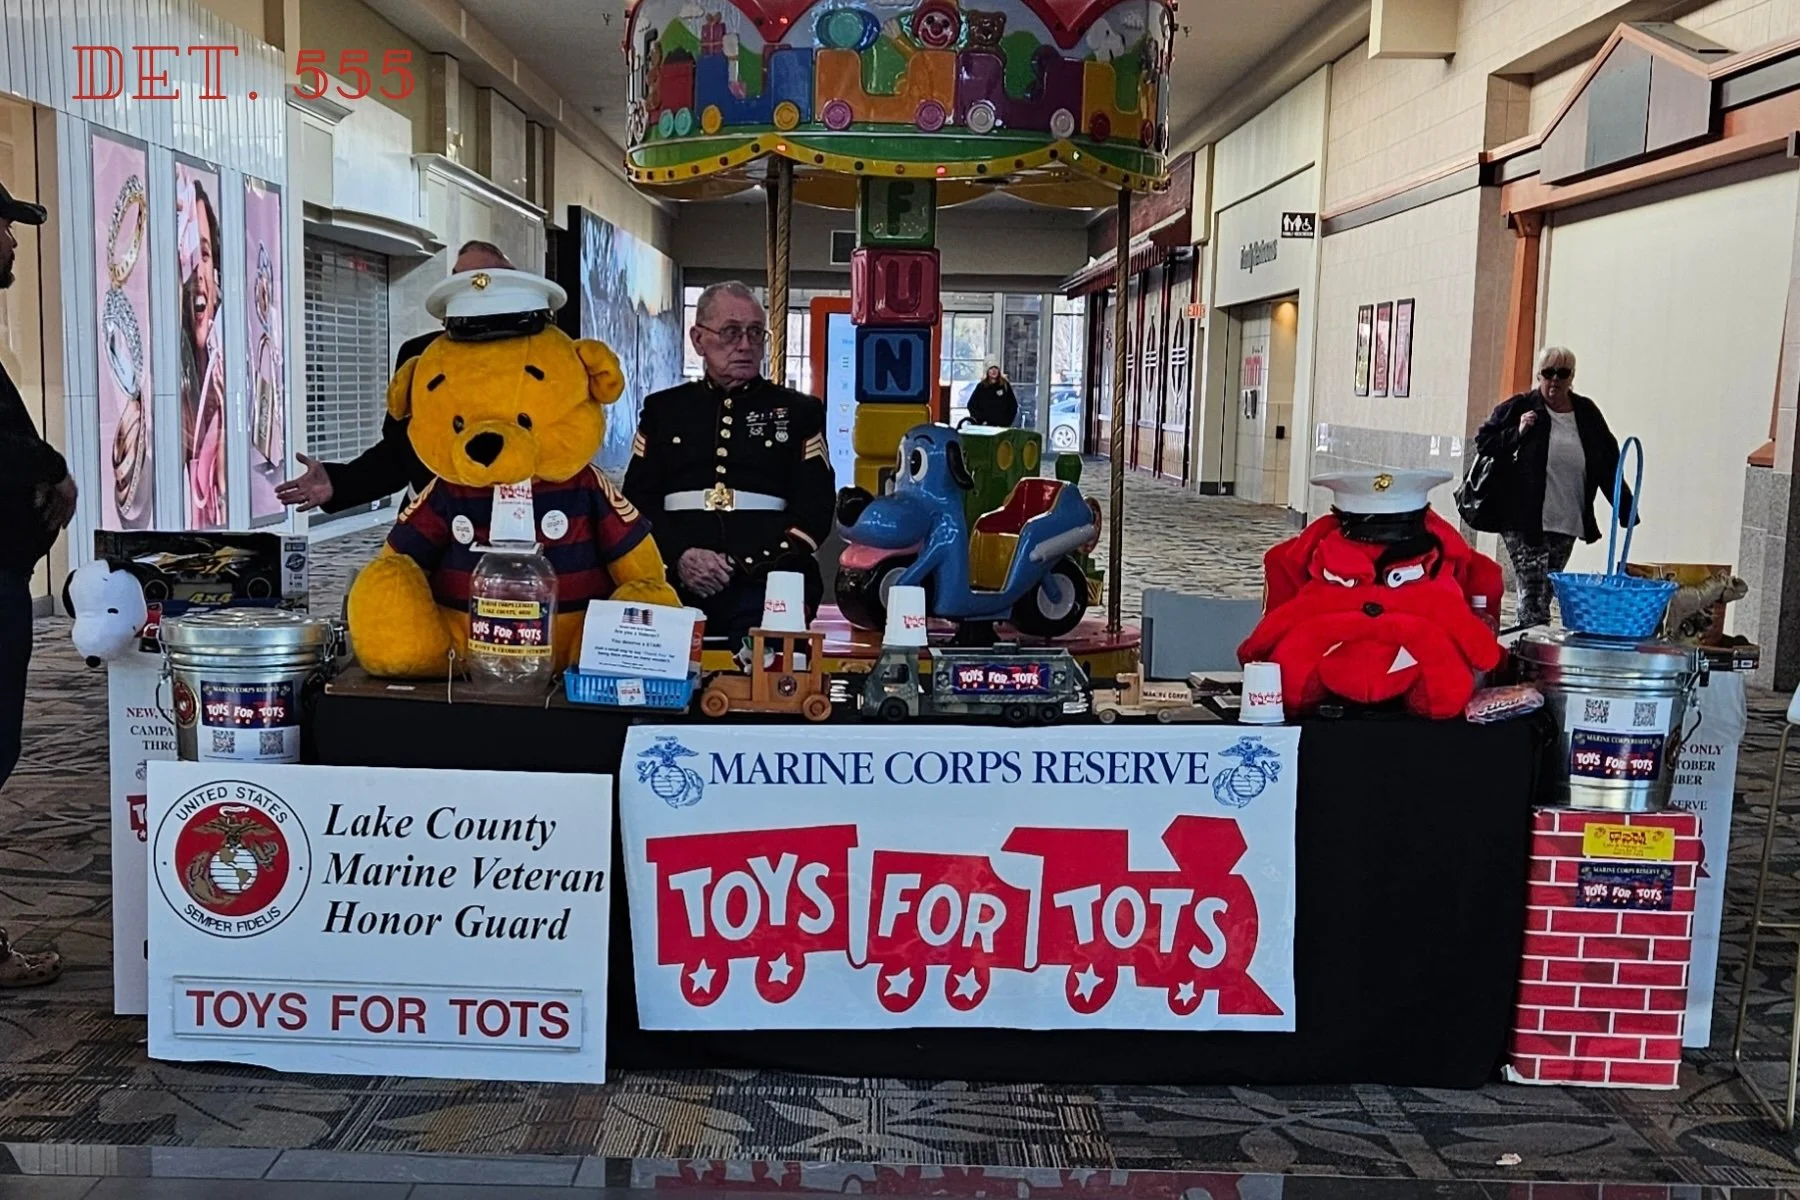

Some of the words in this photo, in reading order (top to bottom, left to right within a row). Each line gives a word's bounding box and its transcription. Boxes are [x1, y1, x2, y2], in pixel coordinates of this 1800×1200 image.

[493, 625, 512, 639] FOR
[517, 628, 542, 640] TOTS
[959, 669, 984, 683] TOYS
[988, 671, 1008, 684] FOR
[1012, 672, 1038, 685] TOTS
[126, 707, 159, 719] NEW,
[206, 704, 230, 716] TOYS
[234, 706, 254, 718] FOR
[259, 706, 284, 718] TOTS
[1576, 752, 1600, 765] TOYS
[1605, 756, 1627, 769] FOR
[1630, 759, 1653, 771] TOTS
[1690, 744, 1724, 755] ONLY
[708, 751, 875, 785] MARINE
[884, 751, 1021, 784] CORPS
[1032, 751, 1210, 784] RESERVE
[175, 786, 228, 822] UNITED
[236, 786, 288, 825] STATES
[322, 803, 414, 838] Lake
[426, 806, 557, 851] County
[321, 852, 457, 889] Marine
[472, 856, 605, 892] Veteran
[1584, 884, 1608, 896] TOYS
[1612, 886, 1631, 898] FOR
[1636, 888, 1662, 901] TOTS
[184, 903, 232, 932] SEMPER
[236, 906, 281, 933] FIDELIS
[321, 900, 442, 936] Honor
[454, 905, 572, 941] Guard
[668, 852, 835, 941] TOYS
[878, 872, 1007, 954] FOR
[1054, 884, 1228, 969] TOTS
[186, 990, 308, 1031] TOYS
[331, 994, 426, 1034] FOR
[448, 998, 570, 1040] TOTS
